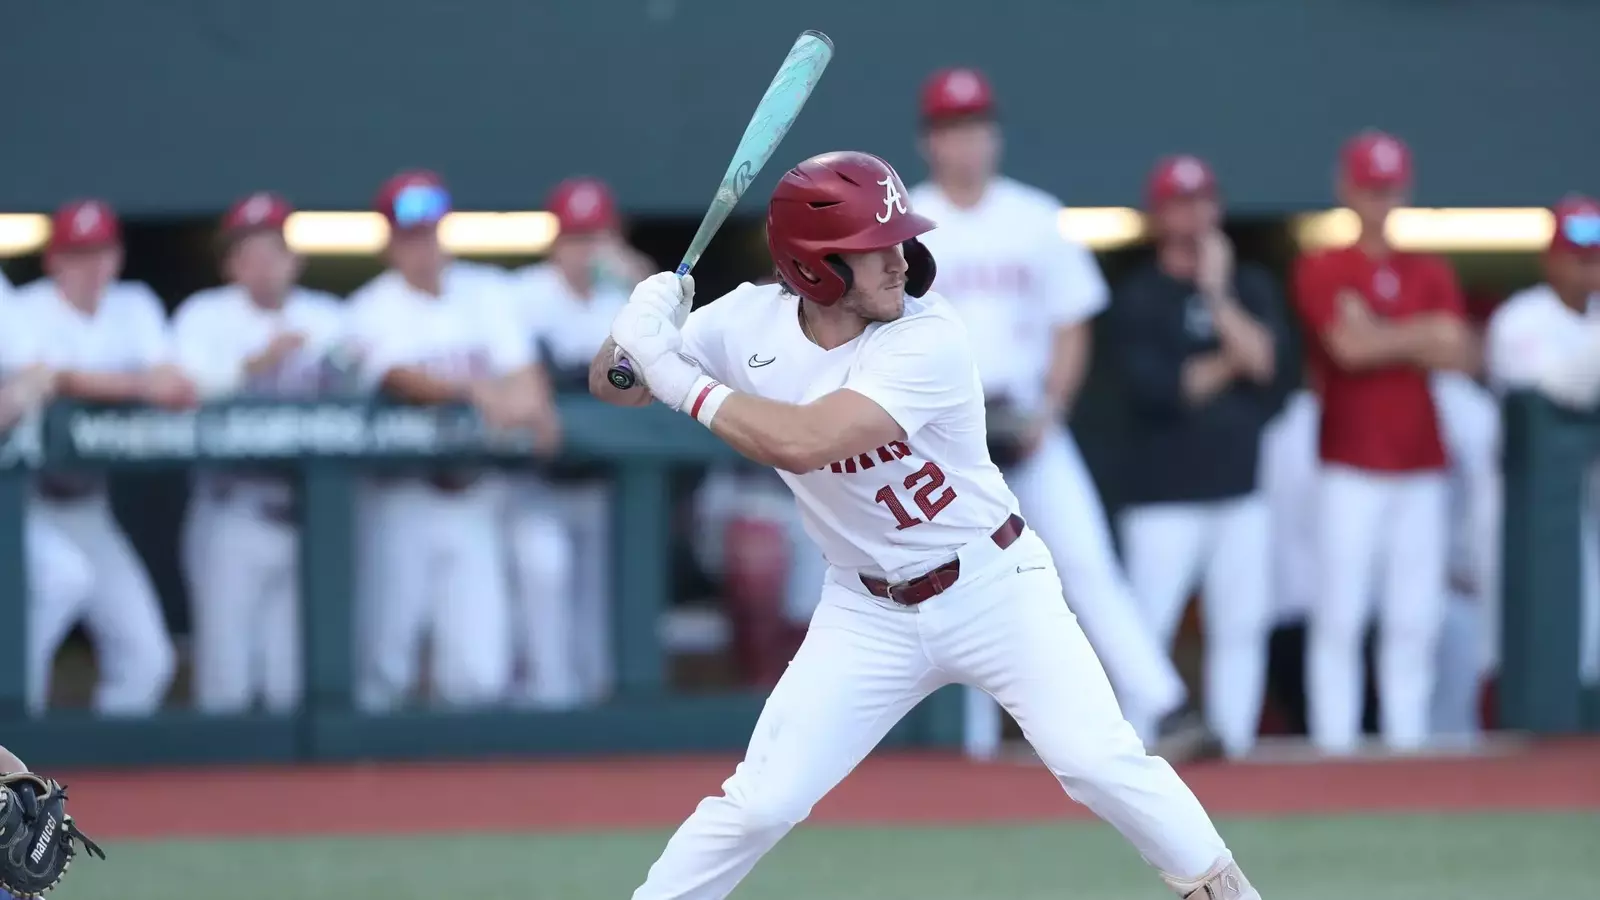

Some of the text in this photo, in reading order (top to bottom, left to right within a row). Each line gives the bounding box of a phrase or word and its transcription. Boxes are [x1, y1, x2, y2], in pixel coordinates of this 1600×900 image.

[875, 175, 907, 223] A
[875, 461, 957, 530] 12
[30, 812, 57, 864] marucci
